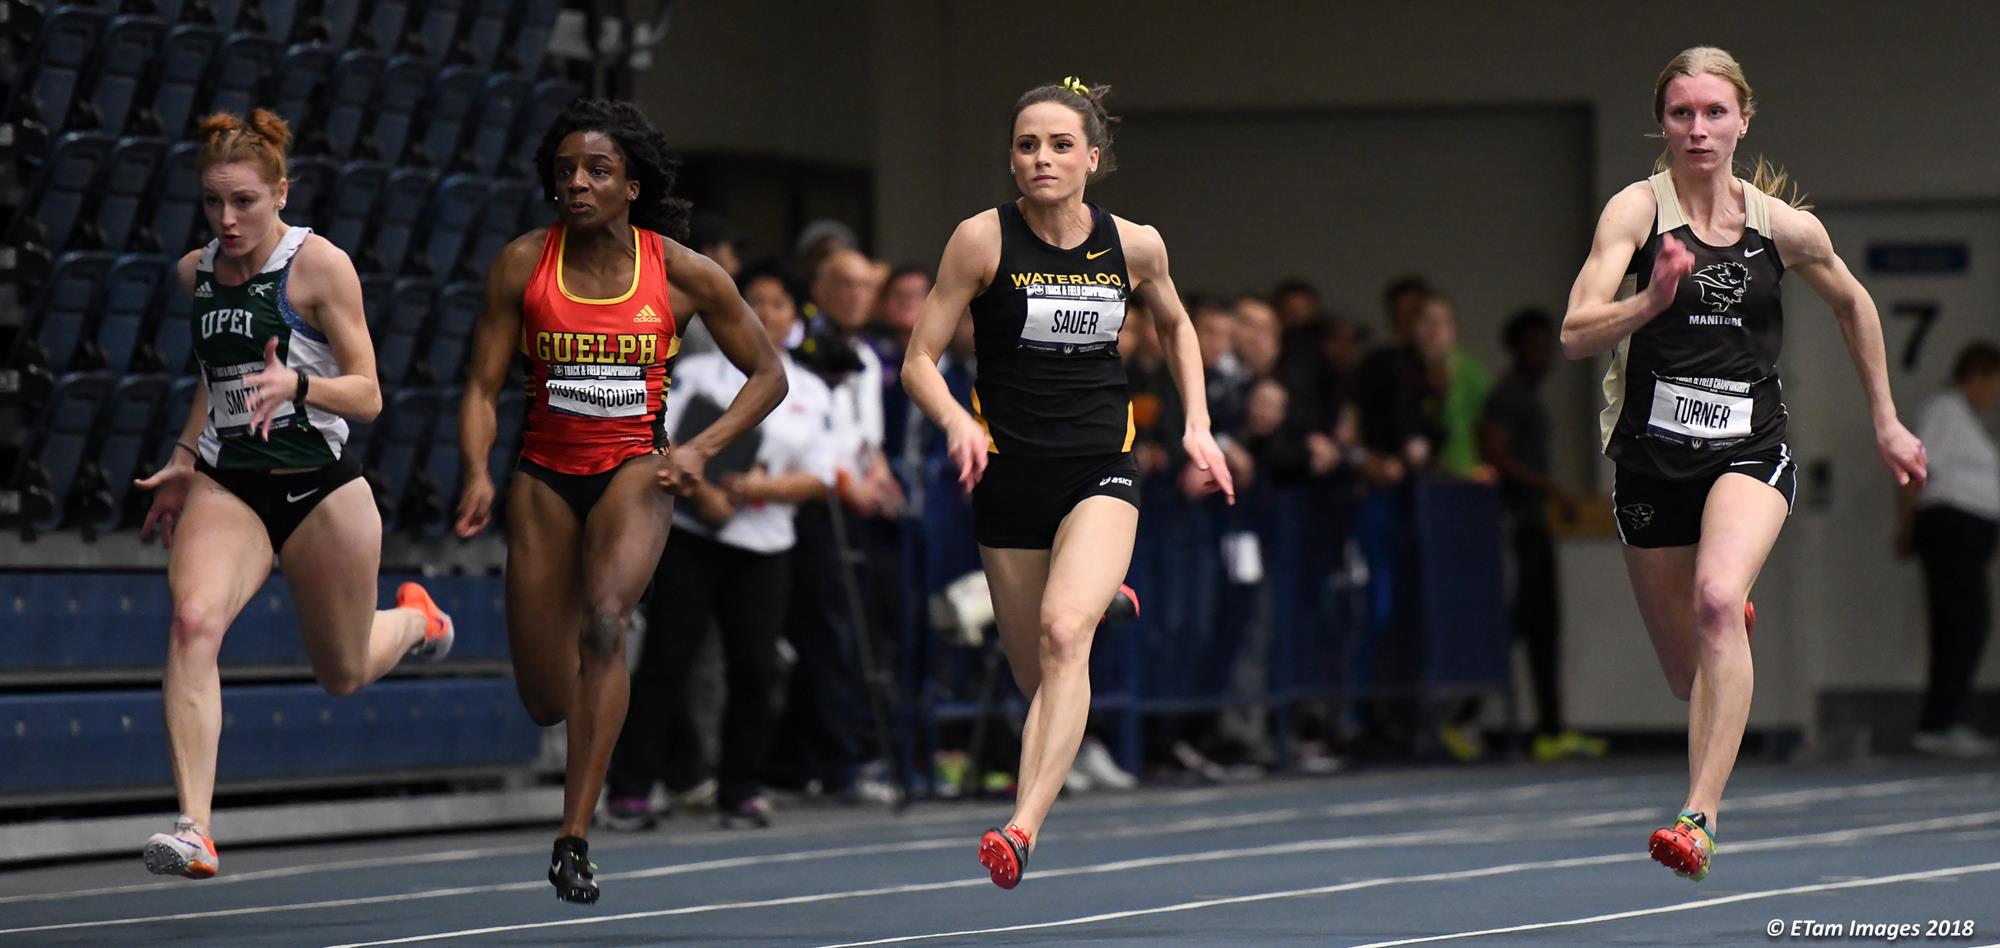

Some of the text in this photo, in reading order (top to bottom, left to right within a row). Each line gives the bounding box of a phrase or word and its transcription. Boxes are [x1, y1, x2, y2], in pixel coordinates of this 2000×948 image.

[1010, 272, 1122, 287] WATERLOO
[201, 308, 254, 340] UPEI
[1051, 309, 1099, 335] SAUER
[1892, 301, 1941, 371] 7
[536, 331, 657, 364] GUELPH
[564, 365, 641, 377] TRACK & FIELD CHAMPIONSHIPS
[1699, 378, 1714, 388] FIELD
[1674, 396, 1730, 429] TURNER
